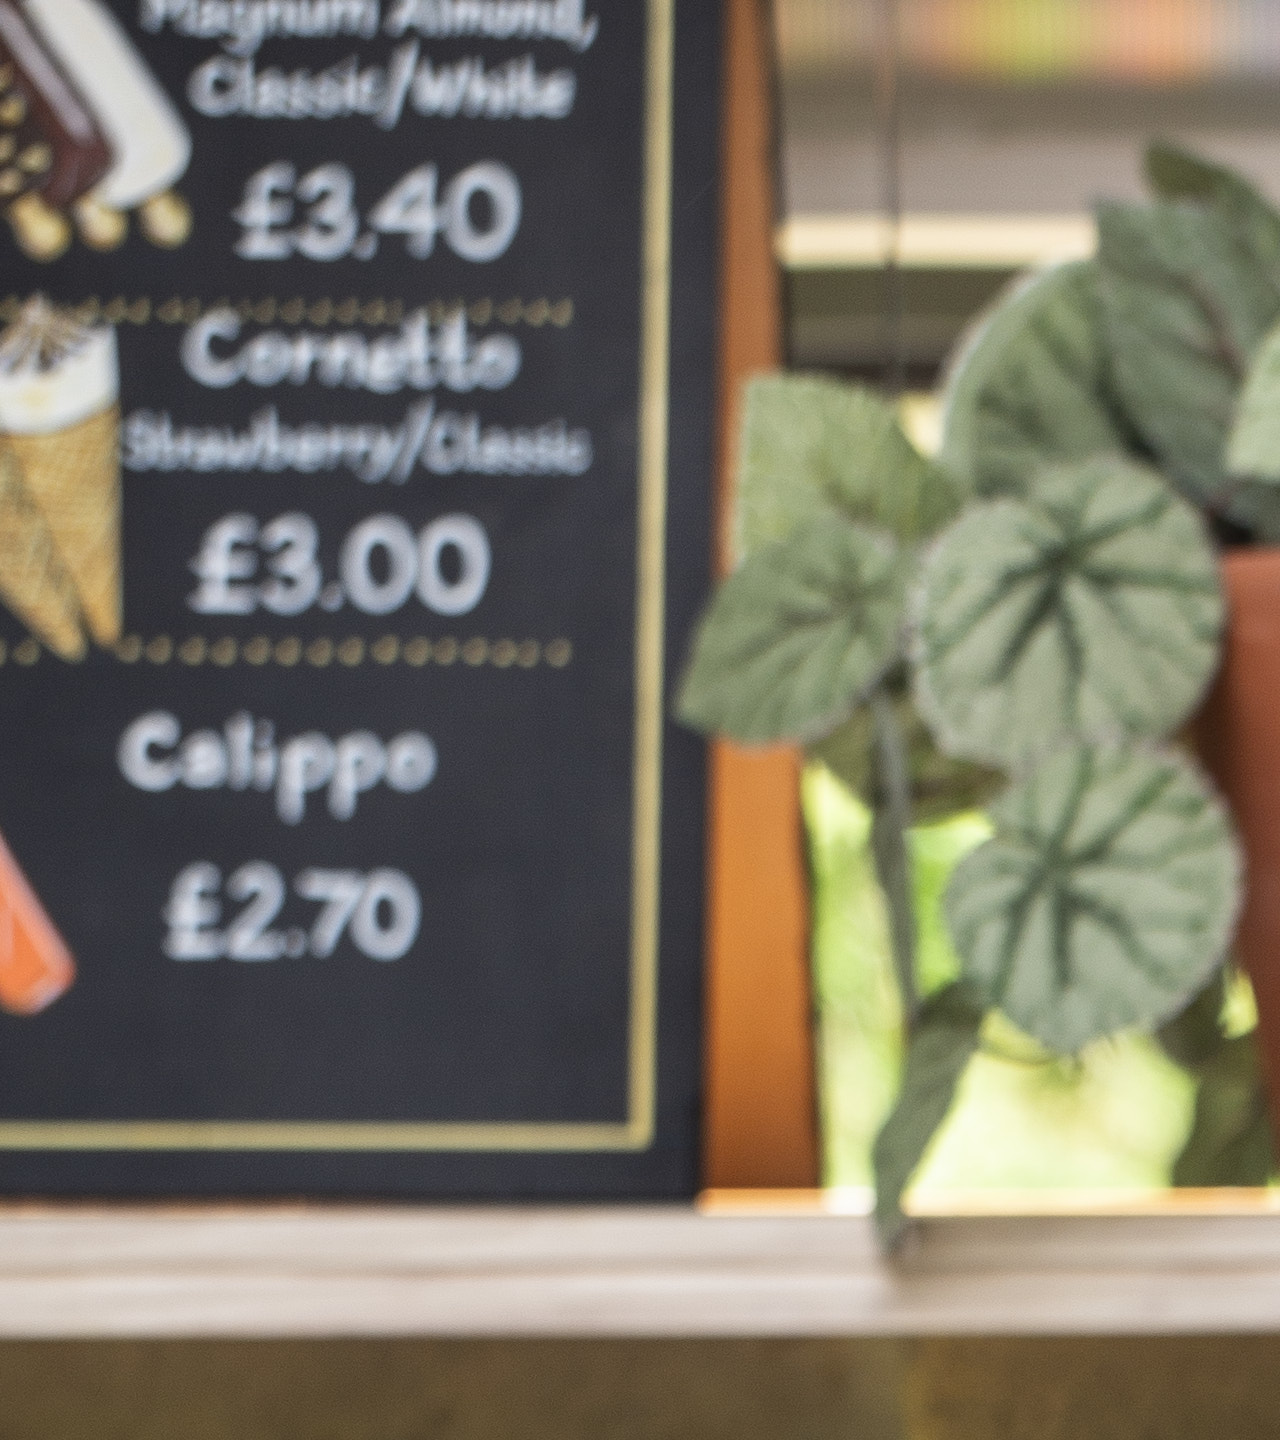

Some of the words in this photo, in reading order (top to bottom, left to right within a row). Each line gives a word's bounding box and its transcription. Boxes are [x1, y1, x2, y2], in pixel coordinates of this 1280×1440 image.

[188, 40, 577, 130] Classic/White
[233, 160, 522, 262] £3.40
[182, 307, 521, 394] Cornetto
[121, 397, 593, 485] Strawberry/Classic
[187, 512, 491, 615] £3.00
[117, 710, 438, 824] Calippo
[163, 859, 421, 961] £2.70
